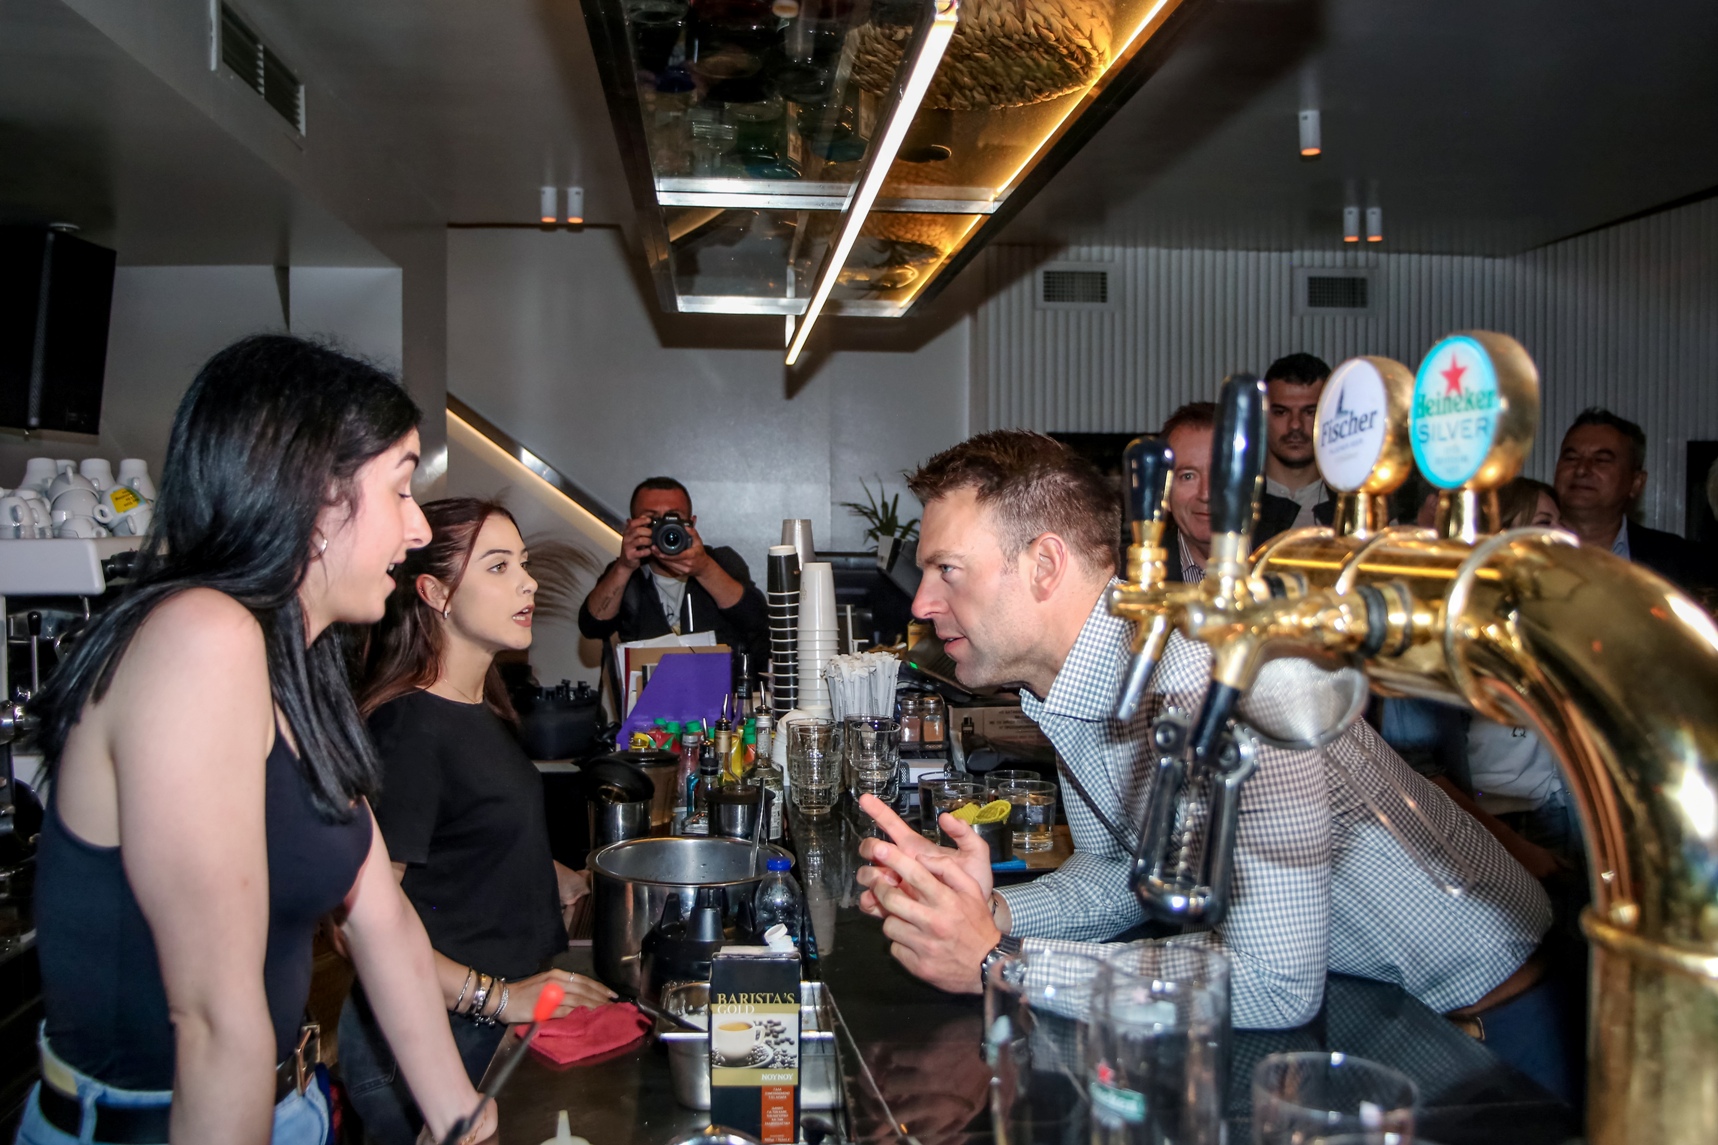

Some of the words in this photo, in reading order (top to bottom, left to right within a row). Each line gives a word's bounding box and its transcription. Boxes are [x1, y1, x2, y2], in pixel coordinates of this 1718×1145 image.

[1321, 409, 1377, 447] Fischer
[1418, 416, 1490, 444] SILVER
[717, 992, 795, 1004] BARISTA'S
[717, 1004, 755, 1015] GOLD
